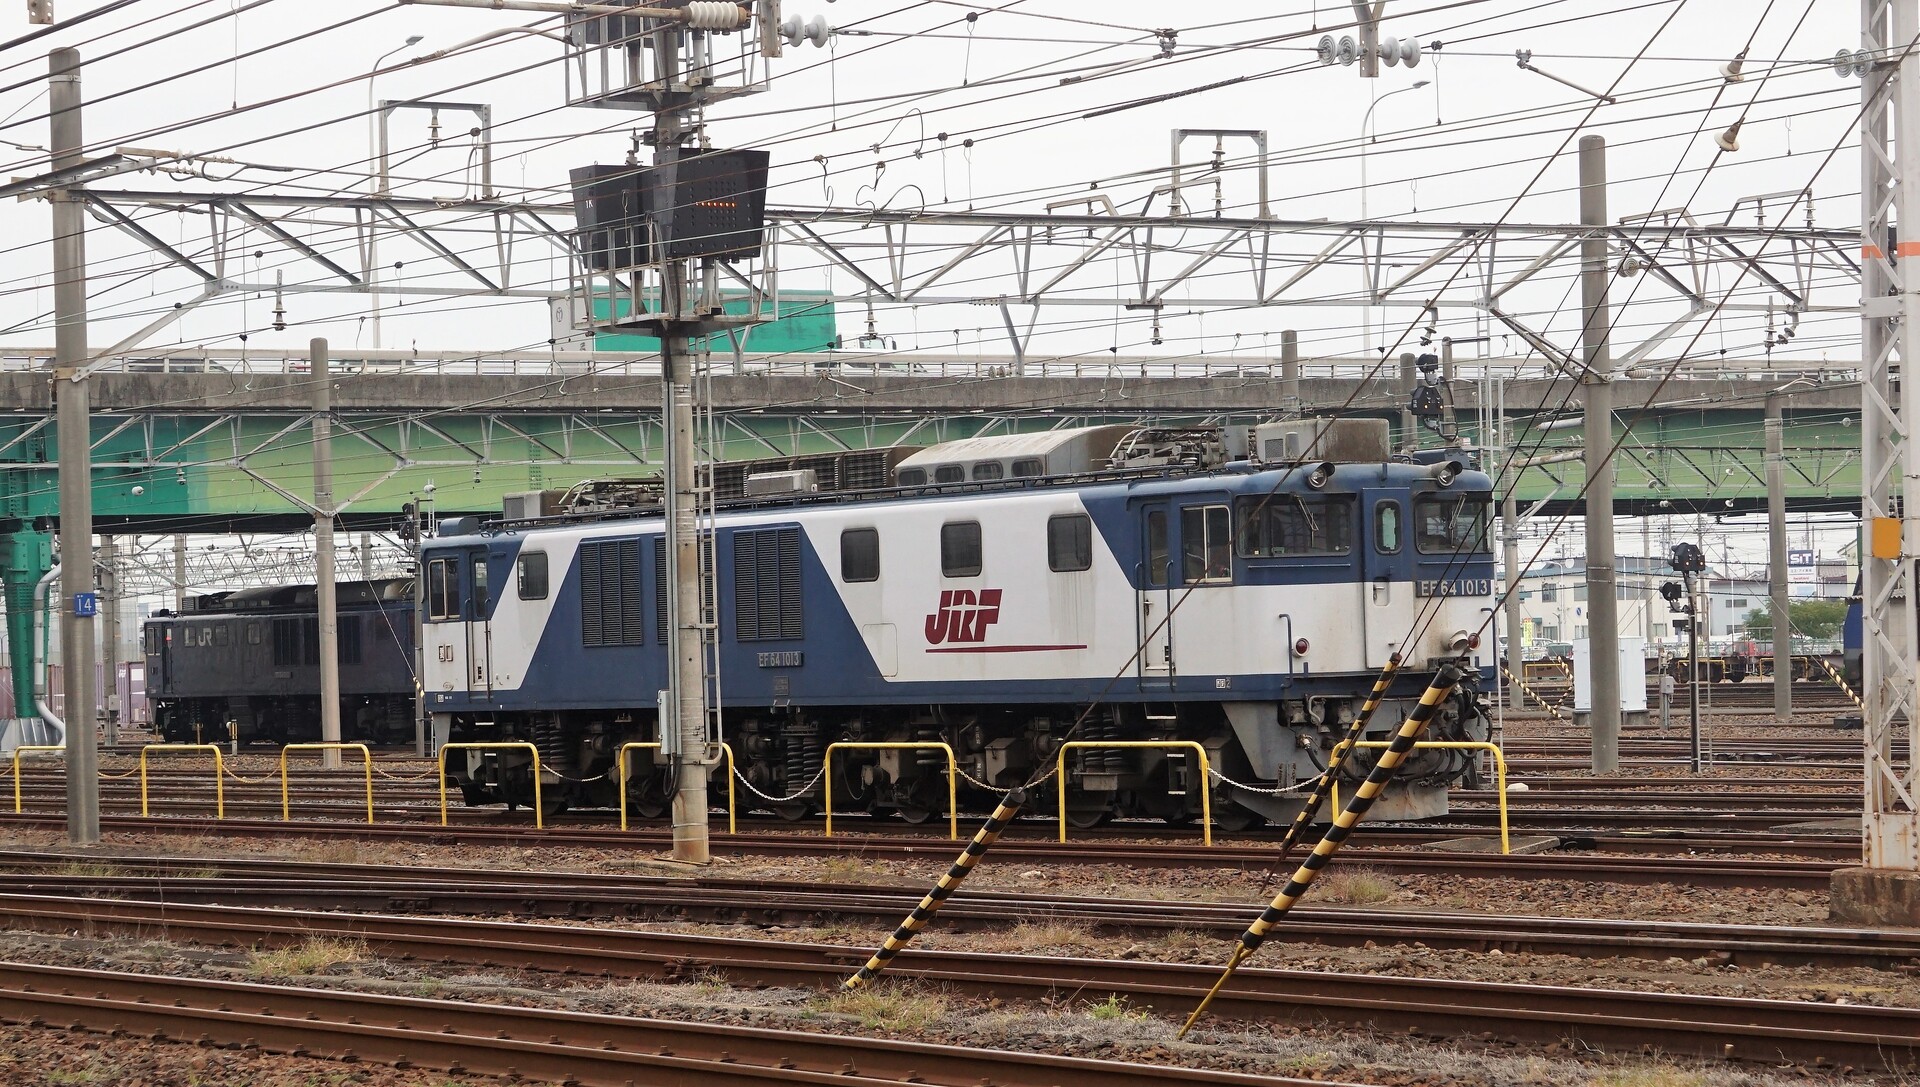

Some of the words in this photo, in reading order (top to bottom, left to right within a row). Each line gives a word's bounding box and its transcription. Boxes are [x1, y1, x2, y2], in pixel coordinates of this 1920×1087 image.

[1421, 580, 1438, 597] EF
[1440, 580, 1457, 596] 64
[1461, 580, 1488, 596] 1013
[924, 588, 1003, 645] JRF
[198, 627, 213, 647] JR
[758, 653, 769, 667] EF
[770, 652, 780, 667] 64
[782, 651, 800, 666] 1013
